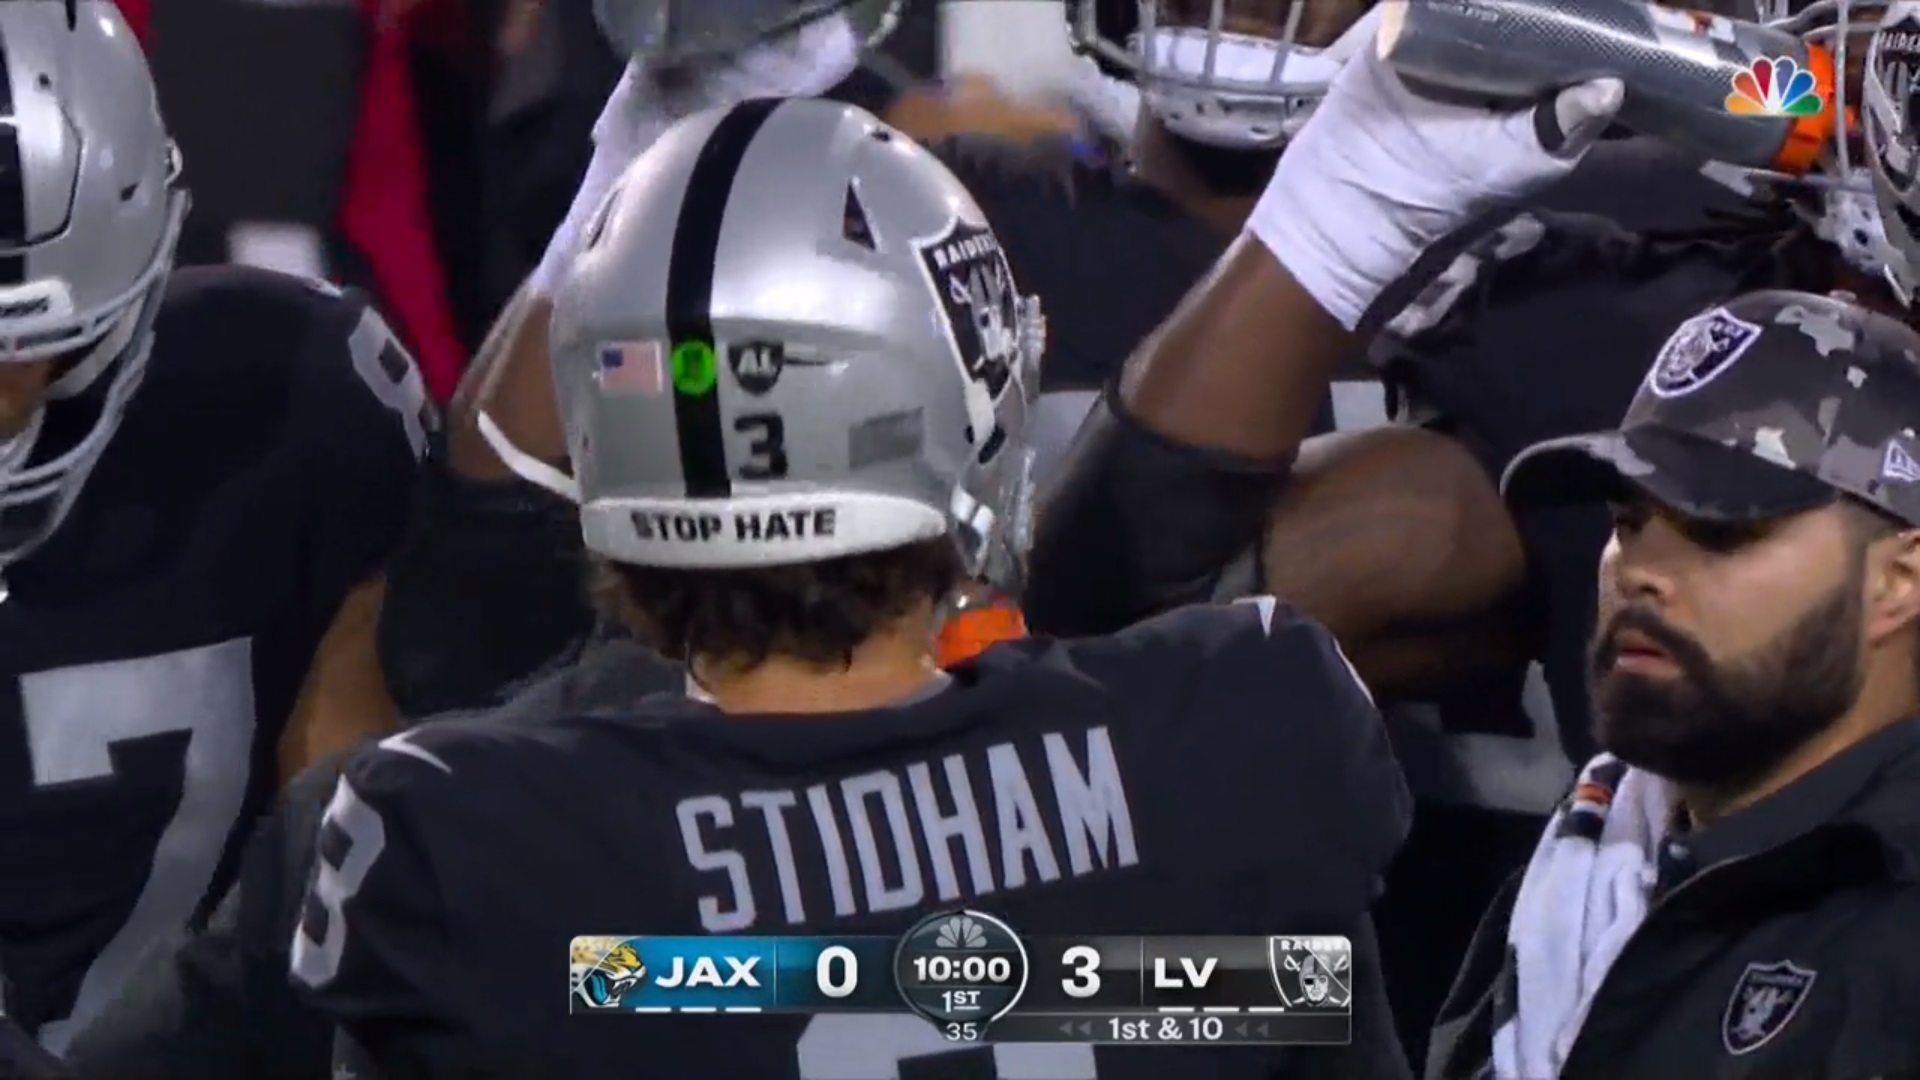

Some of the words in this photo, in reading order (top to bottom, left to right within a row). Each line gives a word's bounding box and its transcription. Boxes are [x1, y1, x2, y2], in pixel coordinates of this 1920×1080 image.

[737, 348, 773, 375] AL
[734, 412, 789, 480] 3
[630, 510, 722, 542] STOP
[734, 508, 836, 542] HATE
[675, 726, 1139, 934] STIDHAM
